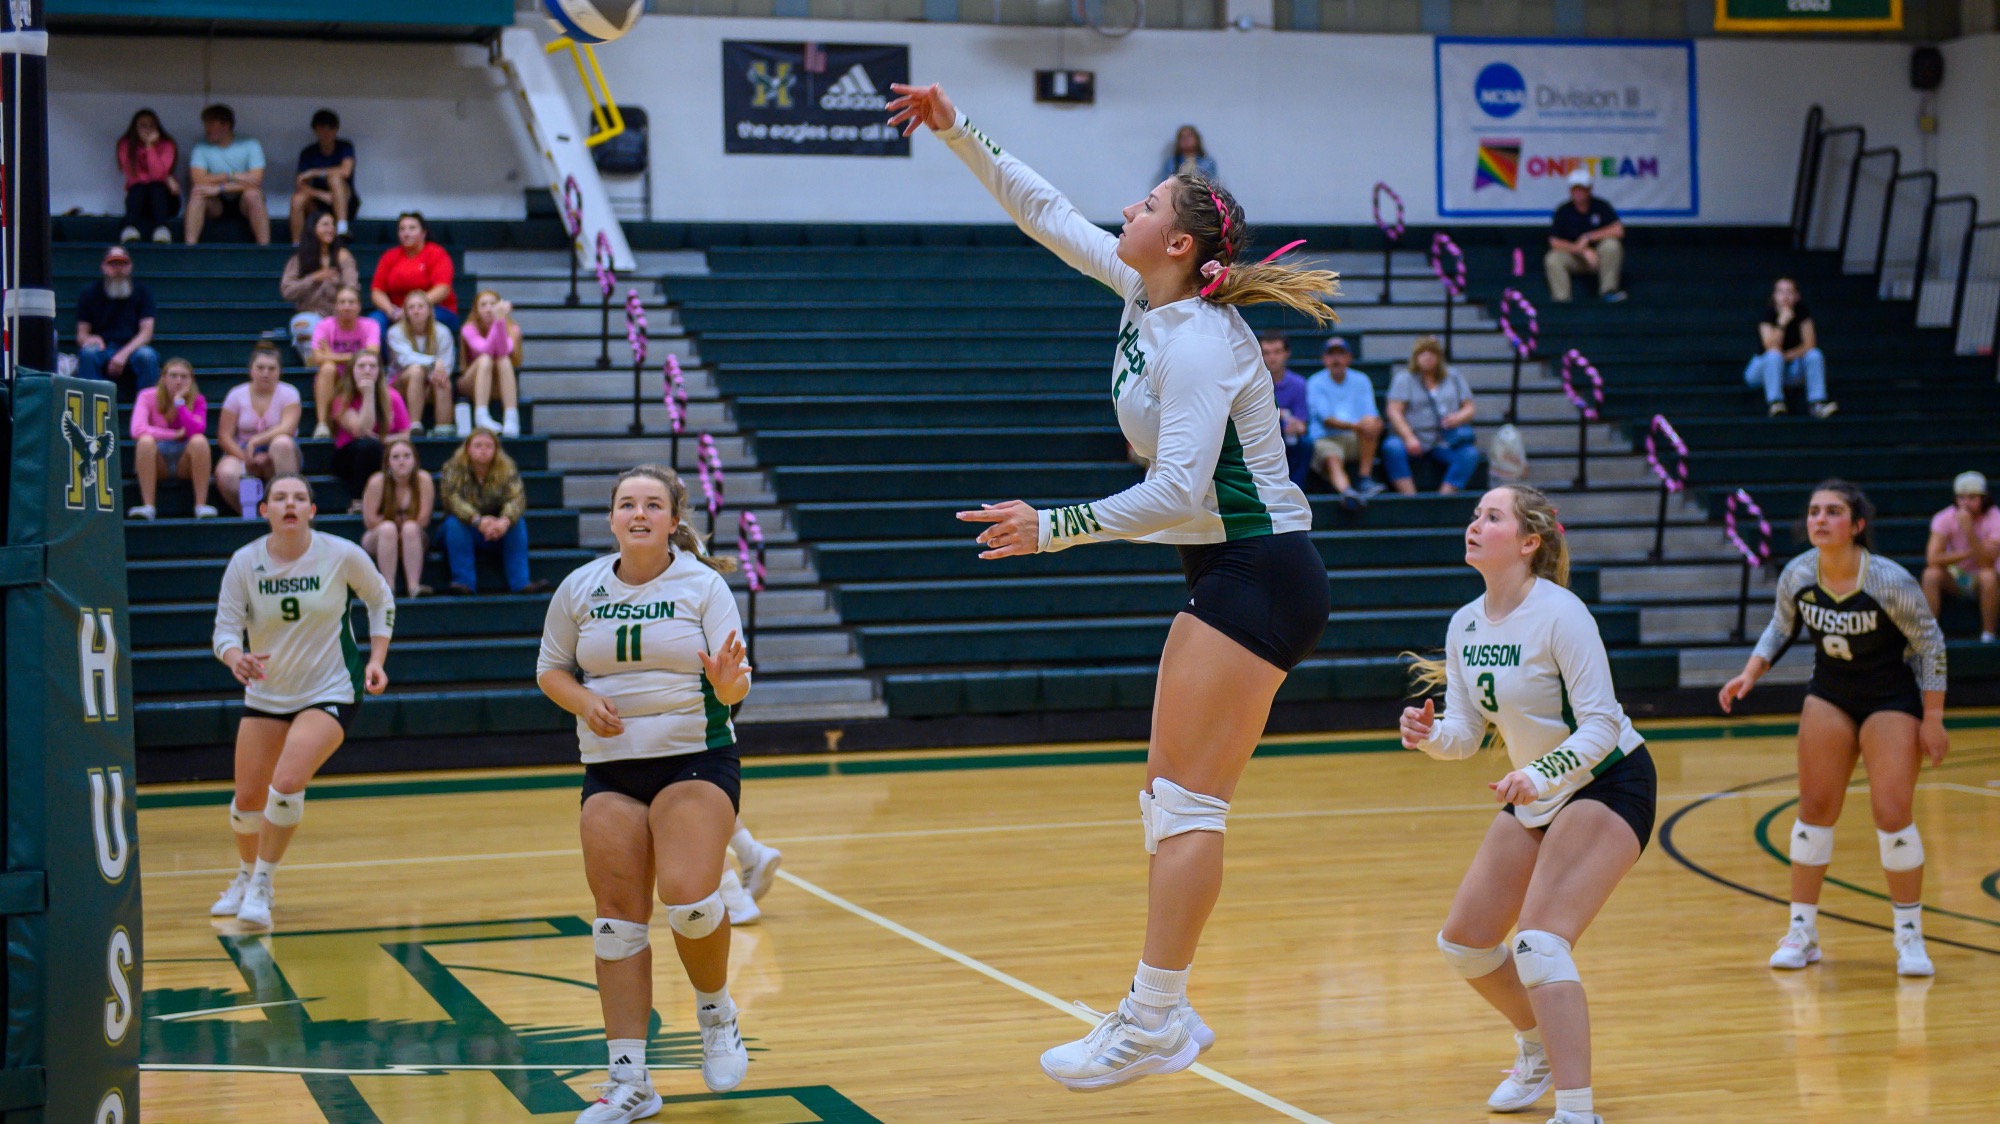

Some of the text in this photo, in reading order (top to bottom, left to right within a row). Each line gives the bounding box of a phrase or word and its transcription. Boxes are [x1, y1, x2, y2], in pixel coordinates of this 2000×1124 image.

[819, 94, 886, 111] adidas
[1535, 84, 1619, 109] Division
[737, 121, 768, 139] the
[769, 123, 828, 143] eagles
[829, 125, 859, 141] are
[860, 122, 880, 141] all
[258, 575, 320, 595] HUSSON
[280, 596, 300, 621] 9
[1799, 600, 1877, 635] HUSSON
[615, 623, 642, 662] 11
[1463, 644, 1521, 666] HUSSON
[1477, 672, 1498, 712] 3
